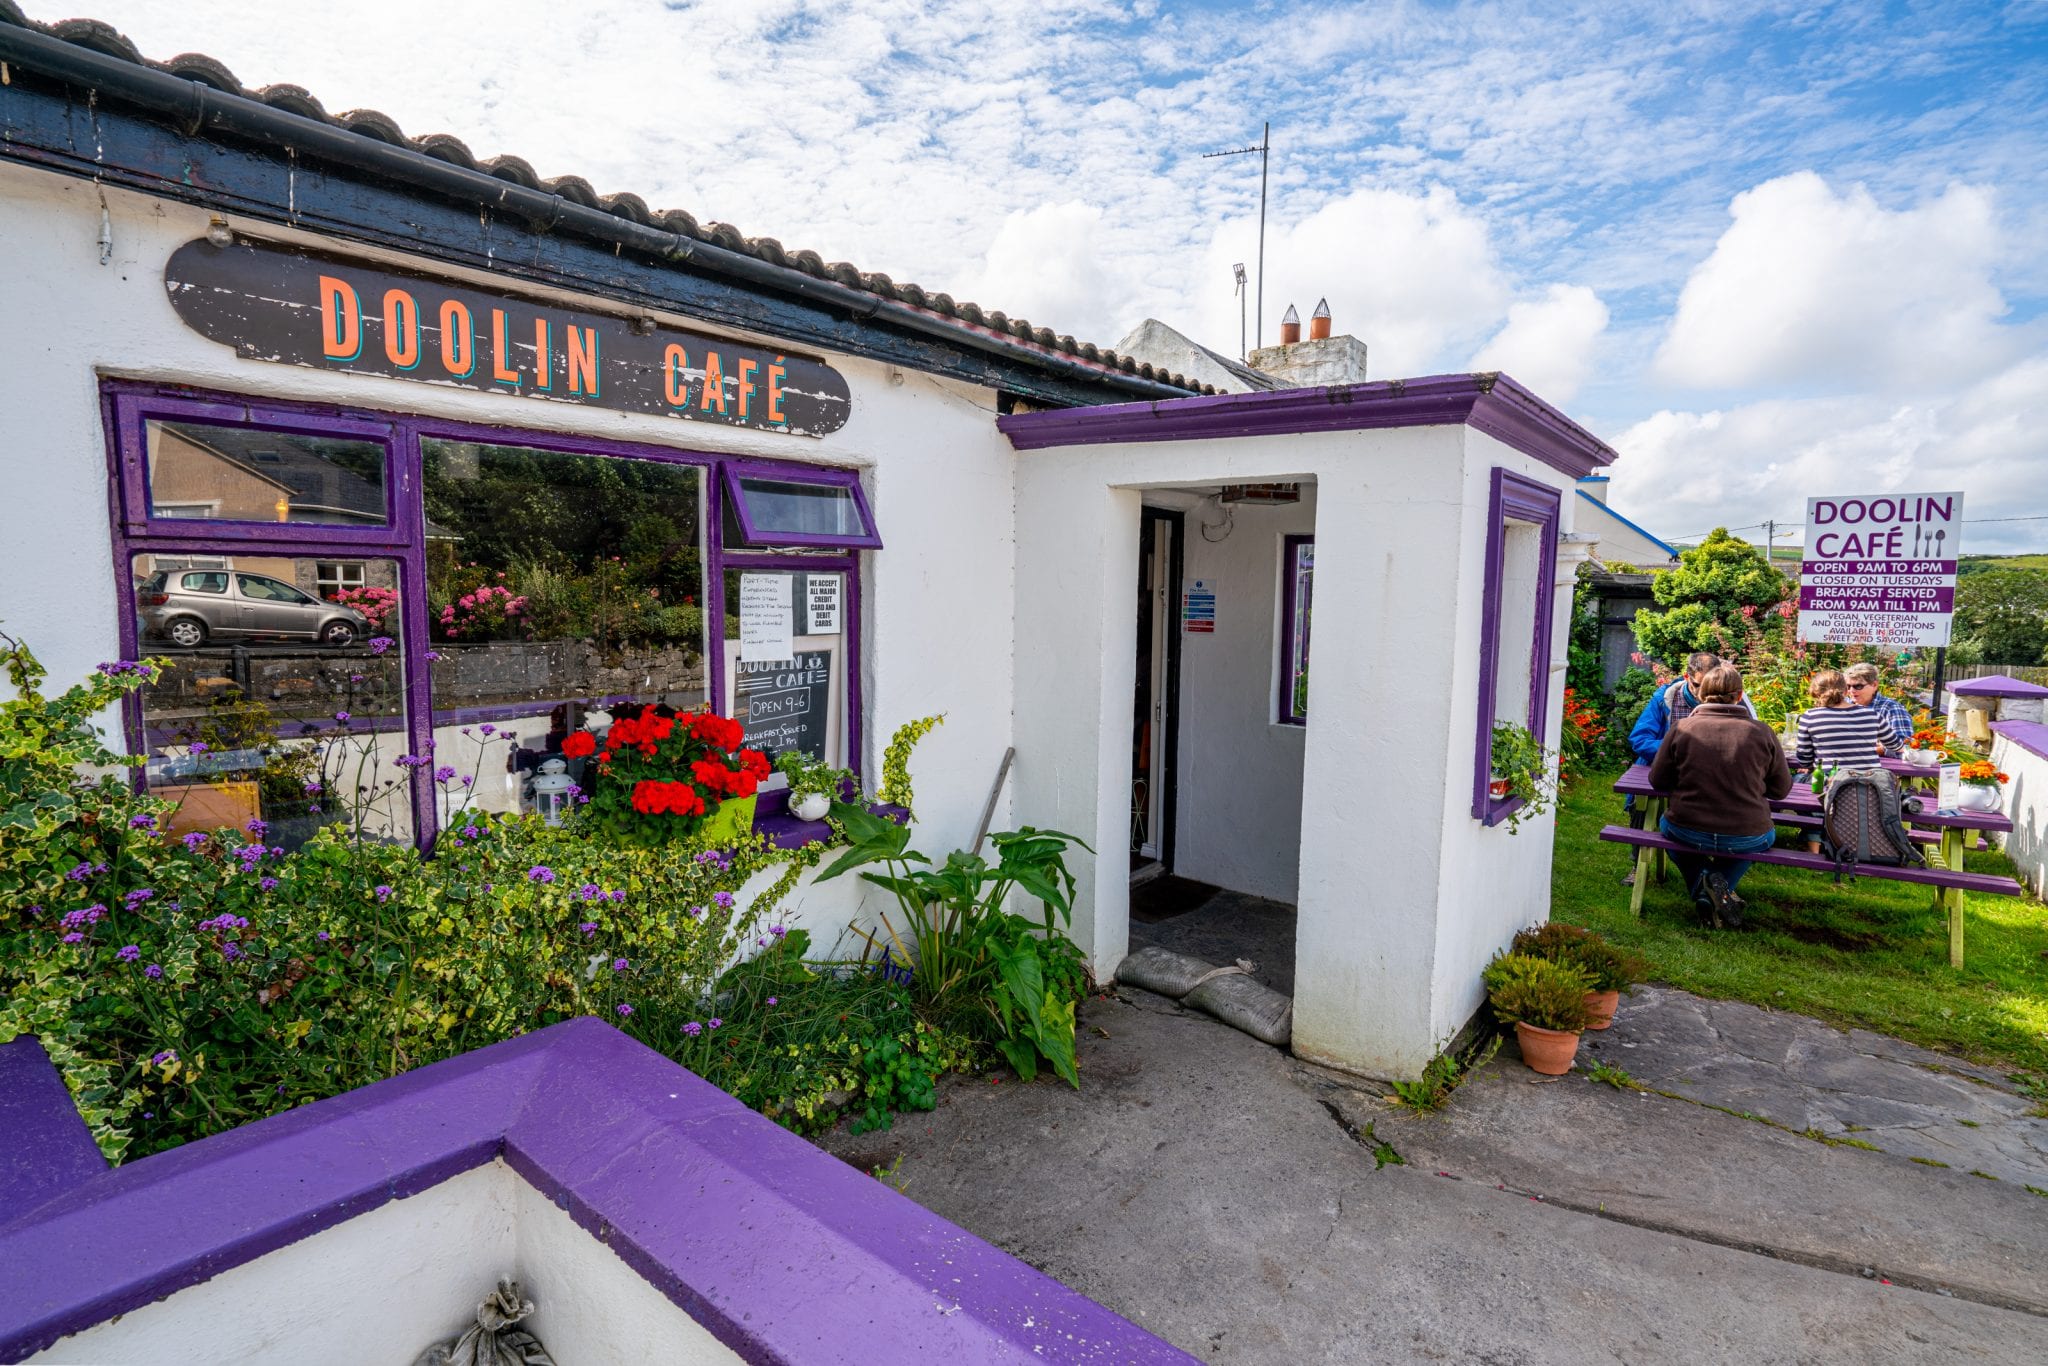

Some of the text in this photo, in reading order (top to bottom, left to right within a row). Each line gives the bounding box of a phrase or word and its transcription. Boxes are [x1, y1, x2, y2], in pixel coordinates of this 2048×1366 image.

[319, 275, 787, 426] DOOLIN CAFÉ
[1815, 496, 1953, 524] DOOLIN
[1816, 526, 1904, 559] CAFÉ
[1814, 562, 1943, 573] OPEN 9AM TO 6PM
[809, 579, 837, 587] WE ACCEPT
[1812, 576, 1943, 585] CLOSED ON TUESDAYS
[809, 587, 837, 595] ALL MAJOR
[1815, 587, 1937, 599] BREAKFAST SERVED
[813, 595, 833, 603] CREDIT
[810, 603, 836, 611] CARD AND
[1810, 599, 1846, 610] FROM
[1849, 600, 1880, 611] 9AM
[1883, 601, 1906, 611] TILL
[815, 611, 831, 619] DEBIT
[1863, 613, 1918, 622] VEGETERIAN
[814, 619, 833, 627] CARDS
[1833, 620, 1868, 628] GLUTEN
[1893, 621, 1936, 630] OPTIONS
[1829, 627, 1914, 637] AVAILABLE IN BOTH
[1823, 634, 1920, 645] SWEET AND SAVOURY
[736, 655, 803, 674] DOOLIN
[776, 671, 815, 688] CAFE
[751, 694, 805, 717] OPEN 9-6
[741, 729, 780, 743] REAKFAST
